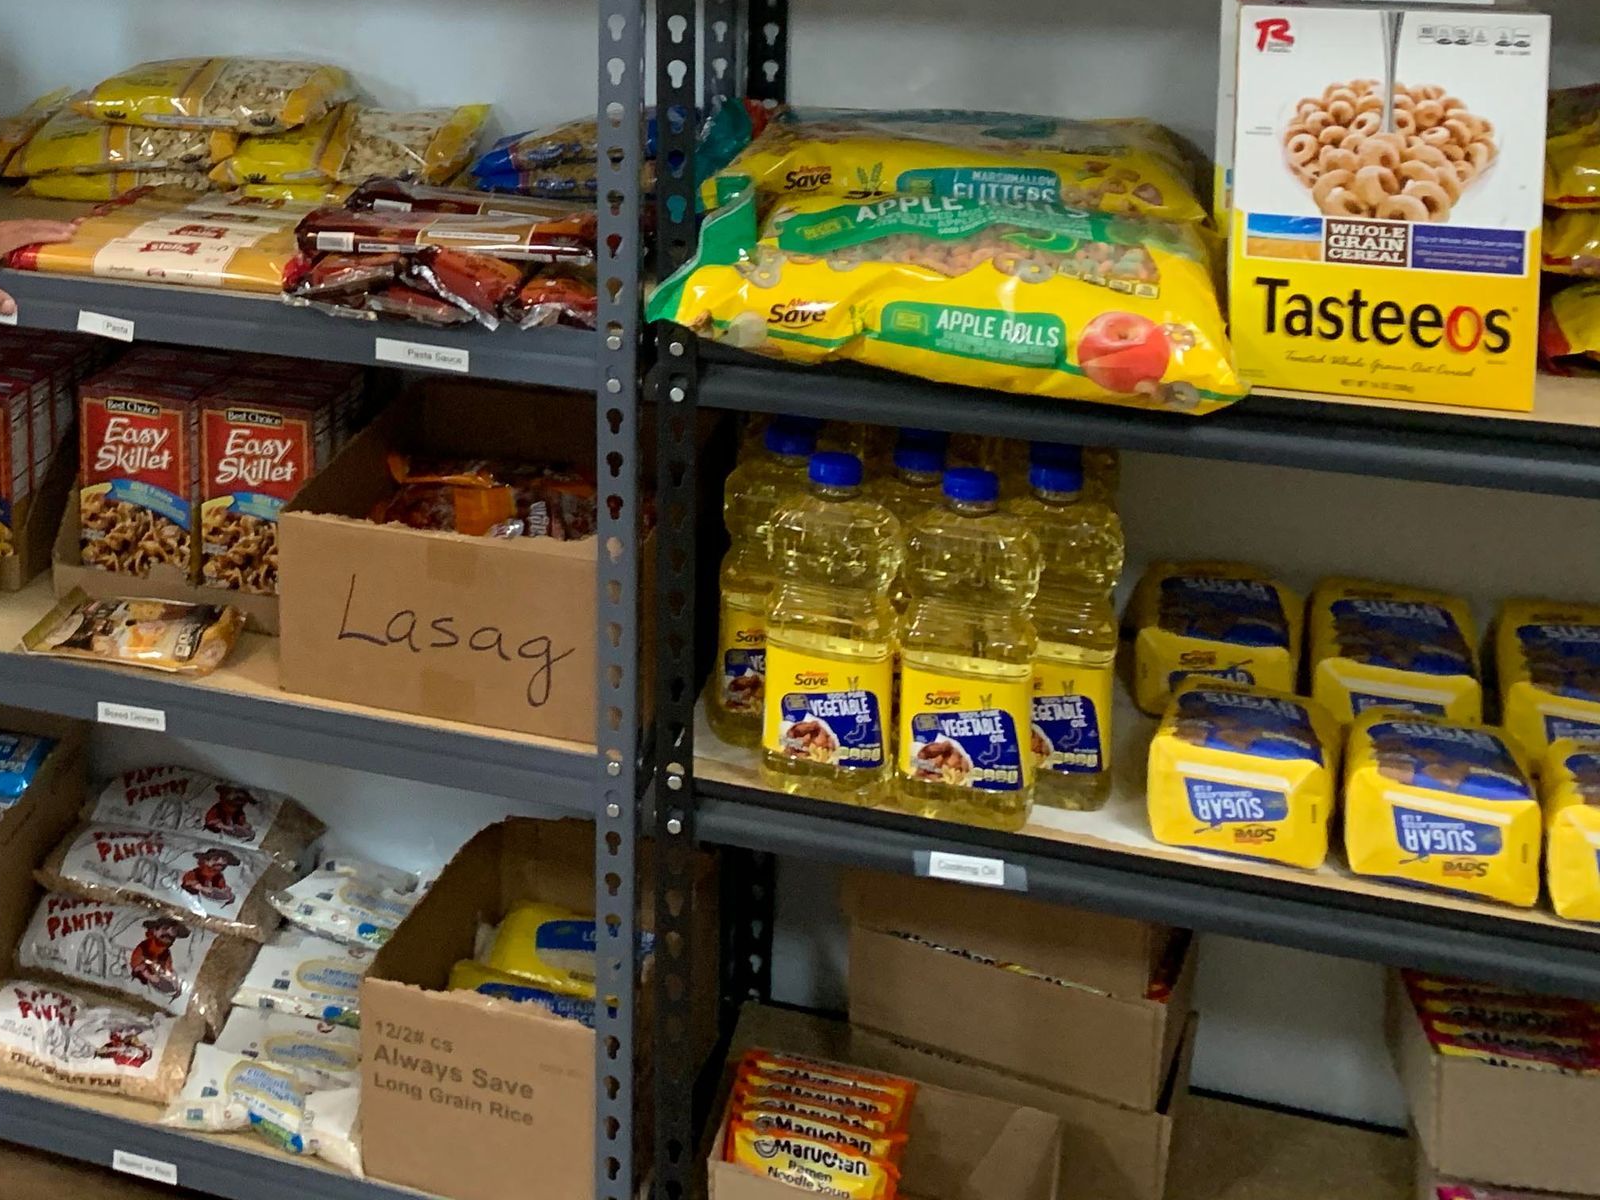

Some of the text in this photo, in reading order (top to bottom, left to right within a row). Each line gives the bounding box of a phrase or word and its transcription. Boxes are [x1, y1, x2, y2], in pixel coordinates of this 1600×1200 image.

[784, 171, 832, 191] Save
[972, 171, 1057, 187] MARSHMALLOW
[857, 196, 963, 222] APPLE
[1329, 235, 1405, 252] GRAIN
[1331, 223, 1405, 238] WHOLE
[1328, 249, 1404, 263] CEREAL
[768, 304, 826, 324] Save
[1255, 277, 1512, 354] Tasteeos
[106, 321, 129, 336] Pasta
[937, 309, 1060, 348] APPLE ROLLS
[407, 349, 434, 360] Pasta
[107, 400, 159, 416] Best Choice
[227, 411, 282, 425] Best Choice
[104, 417, 170, 451] Easy
[225, 428, 292, 462] Easy
[94, 445, 172, 474] Skillet
[215, 457, 297, 486] Skillet
[1182, 578, 1270, 600] SUGAR
[1354, 601, 1448, 627] SUGAR
[338, 574, 575, 707] Lasag
[794, 673, 829, 686] Save
[810, 698, 870, 718] VEGETABLE
[924, 693, 960, 706] Save
[1203, 692, 1300, 720] SUGAR
[941, 717, 1005, 737] VEGETABLE
[1393, 722, 1500, 752] SUGAR
[126, 779, 189, 806] PANTRY
[1197, 798, 1264, 820] SUGAR
[1404, 829, 1477, 852] SUGAR
[47, 911, 114, 940] PANTRY
[374, 1020, 454, 1054] 12/2# cs
[373, 1045, 535, 1100] Always Save
[373, 1072, 534, 1126] Long Grain Rice
[775, 1116, 872, 1153] Maruchan
[775, 1139, 867, 1176] Maruchan
[768, 1166, 850, 1200] Noodle Soup
[789, 1160, 832, 1182] Ramen
